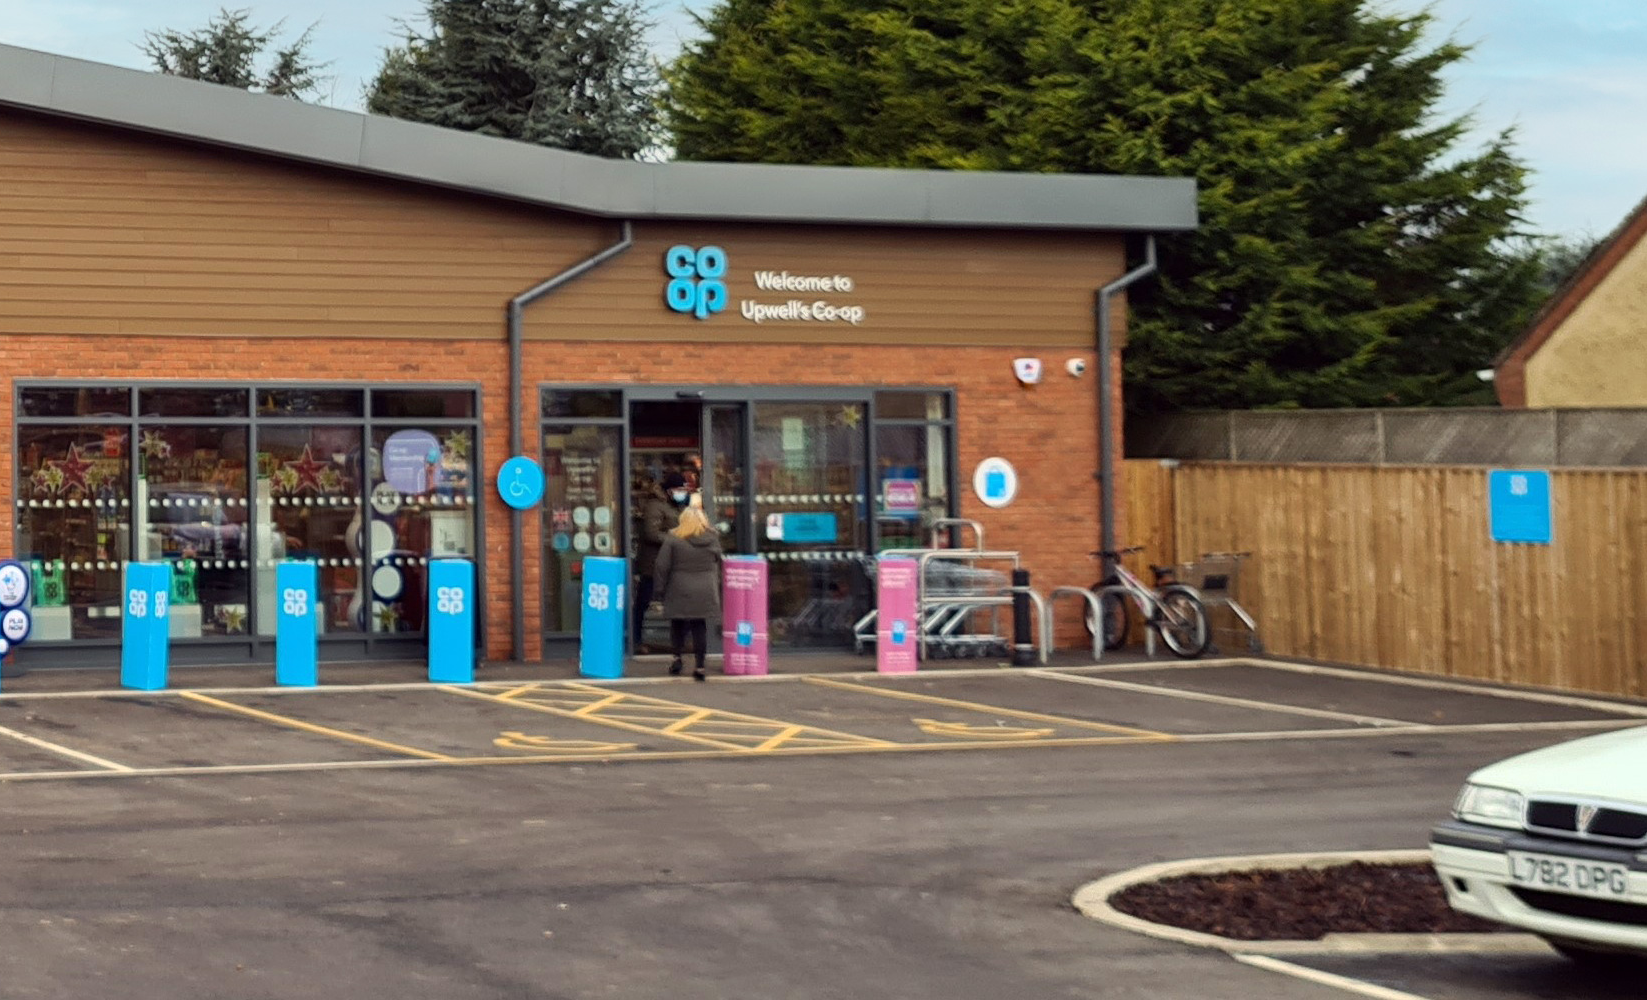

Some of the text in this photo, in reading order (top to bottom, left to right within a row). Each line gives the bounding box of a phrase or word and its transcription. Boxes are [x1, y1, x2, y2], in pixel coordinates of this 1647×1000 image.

[754, 270, 853, 292] Welcome to
[740, 299, 864, 325] Upwell's Co-op
[1509, 857, 1626, 895] L782 DPG
